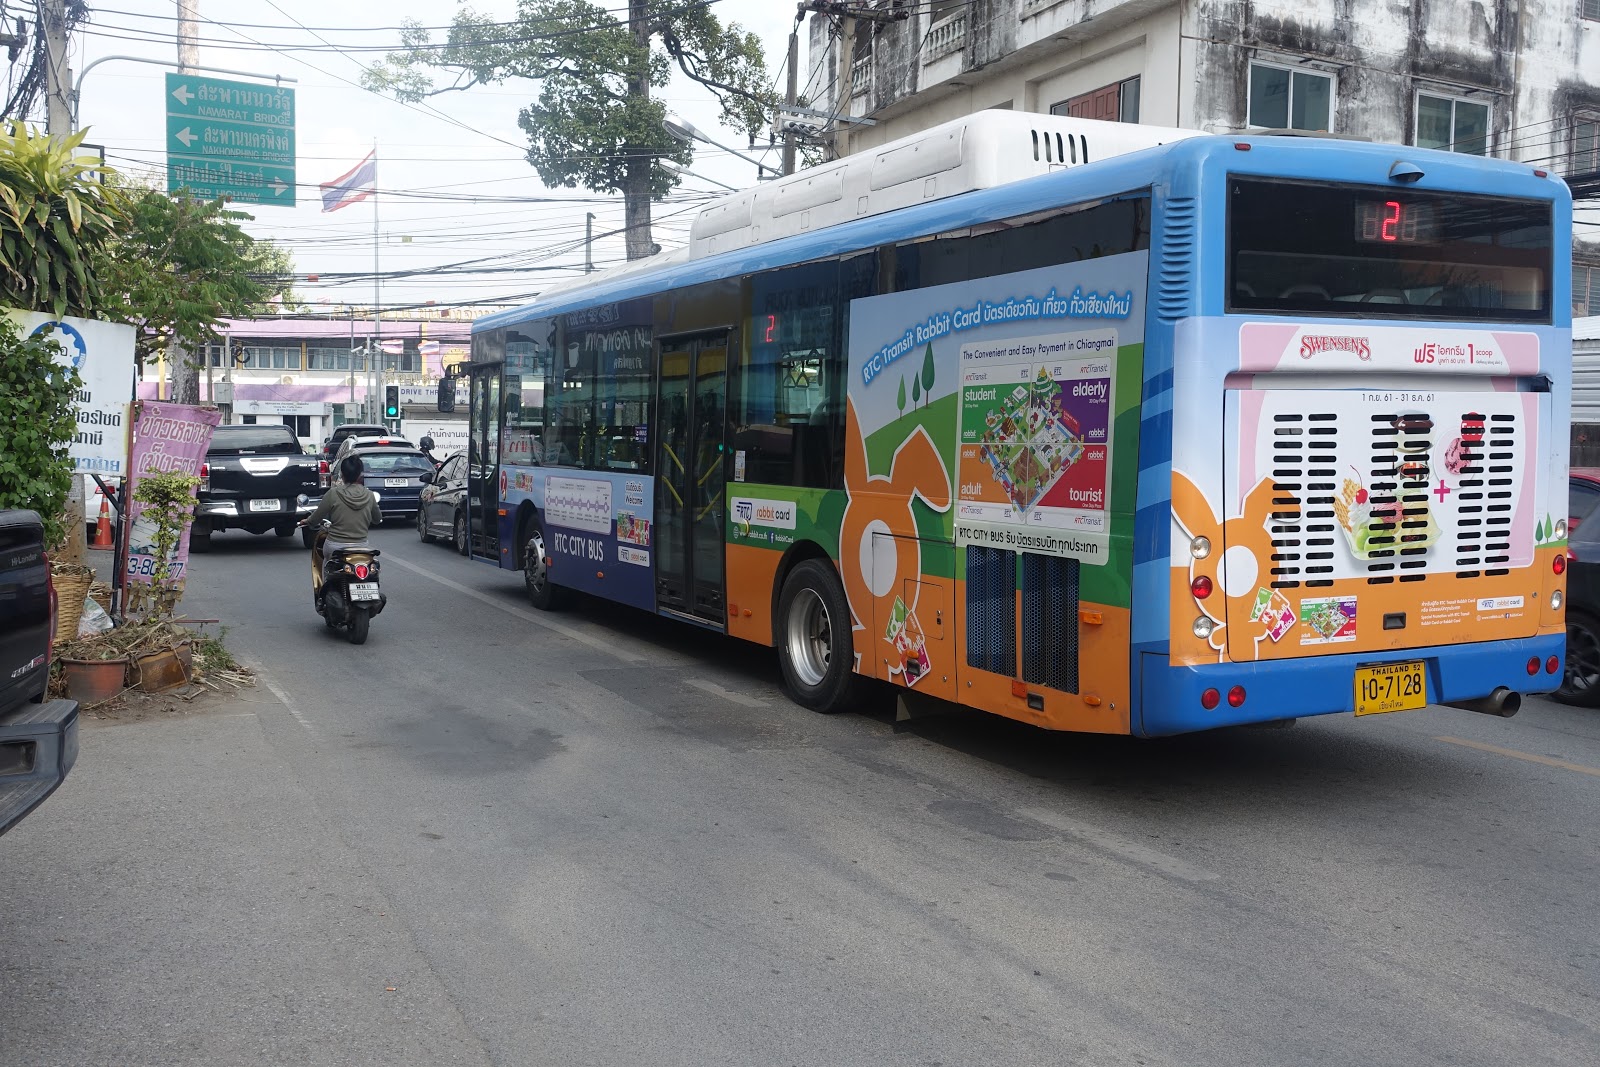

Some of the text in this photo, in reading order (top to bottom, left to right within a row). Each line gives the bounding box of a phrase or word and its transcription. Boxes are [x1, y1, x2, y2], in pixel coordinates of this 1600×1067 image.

[198, 83, 290, 116] สะพานนวรัฐ
[198, 106, 290, 125] NAWARAT BRIDGE
[204, 126, 289, 151] สะพานนครพิงค์
[202, 145, 290, 162] NAKHONPHING BRIDGE
[1382, 201, 1400, 240] 2
[765, 315, 775, 342] 2
[863, 289, 1130, 383] RTC Transit Rabbit Card บัตรเดียวกิน เที่ยว ทั่วเชียงใหม่
[963, 336, 1114, 361] The Convenient and Easy Payment in Chiangmai
[1300, 335, 1372, 361] SWENSEN'S
[1414, 343, 1493, 364] ฟรี ไอศกรีม 1 scoop
[400, 388, 422, 396] DRIVE
[965, 388, 996, 401] student
[1072, 381, 1107, 398] elderly
[1384, 393, 1392, 401] 61
[1401, 393, 1408, 401] 31
[1427, 393, 1435, 401] 61
[963, 430, 976, 438] rabbit
[1088, 428, 1105, 437] rabbit
[1087, 451, 1104, 460] rabbit
[961, 482, 982, 495] adult
[1069, 487, 1103, 502] tourist
[625, 495, 643, 506] Welcome
[738, 504, 791, 521] RTC rabbit card
[959, 527, 971, 538] RTC
[973, 529, 988, 541] CITY
[990, 531, 1004, 543] BUS
[554, 533, 604, 561] RTC CITY BUS
[1371, 665, 1409, 676] THAILAND
[1362, 672, 1421, 702] 10-7128
